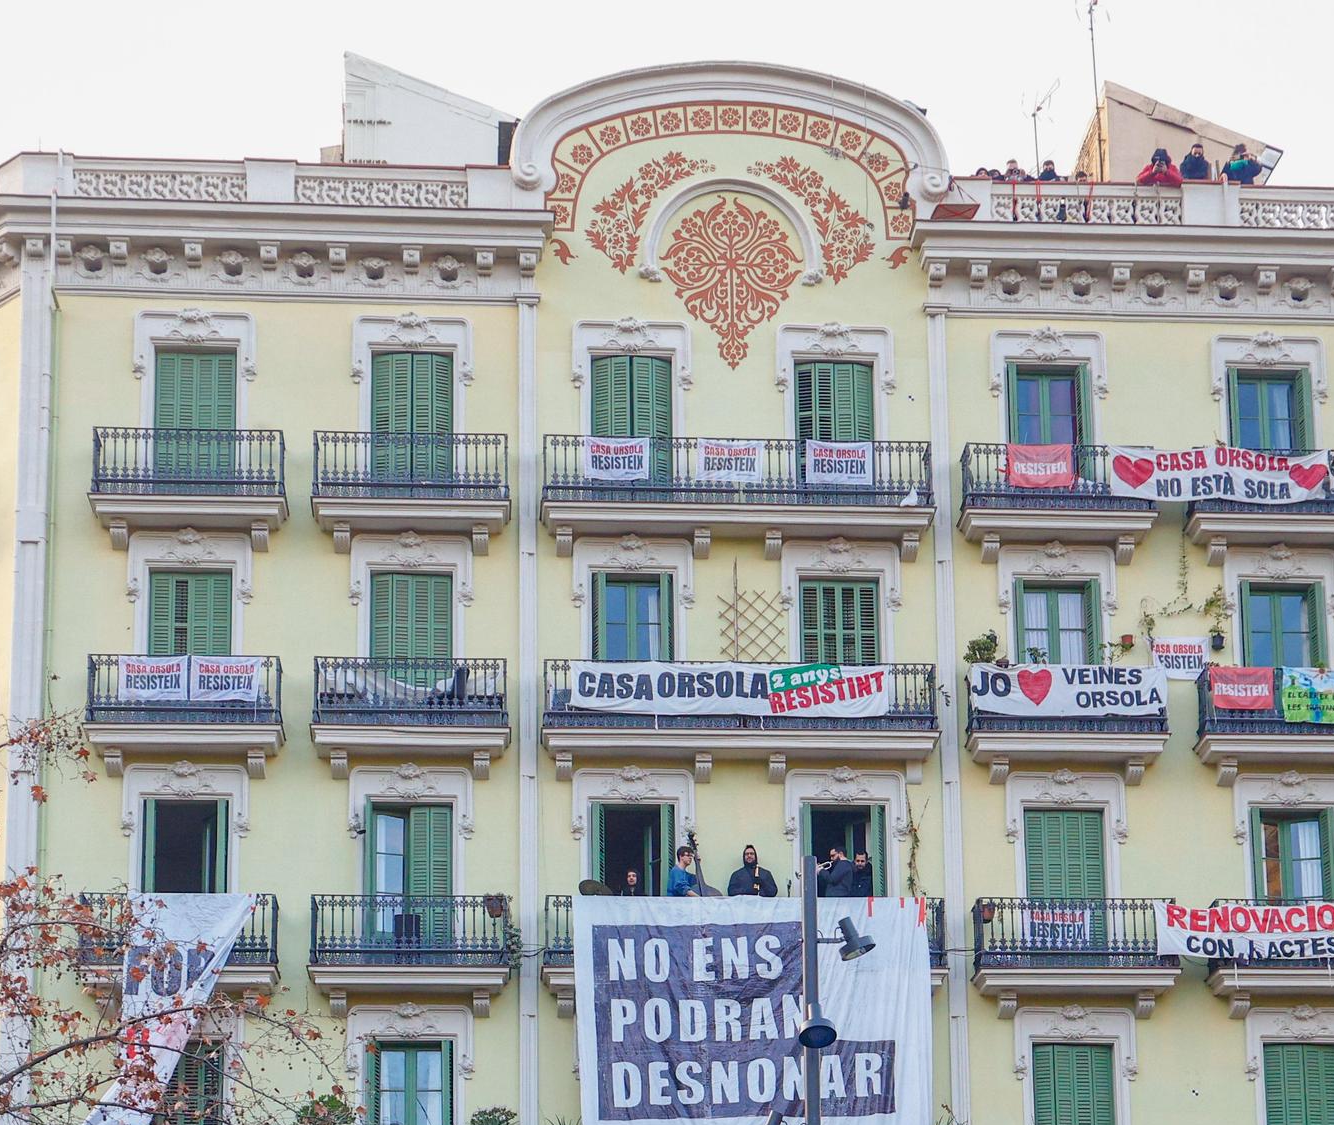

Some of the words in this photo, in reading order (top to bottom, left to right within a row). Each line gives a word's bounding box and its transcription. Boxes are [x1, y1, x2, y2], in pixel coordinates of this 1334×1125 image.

[590, 444, 611, 456] CASA
[613, 444, 644, 456] ORSOLA
[704, 445, 725, 457] CASA
[727, 446, 757, 457] ORSOLA
[813, 447, 834, 459] CASA
[836, 448, 866, 459] ORSOLA
[591, 455, 644, 471] RESISTEIX
[704, 456, 757, 472] RESISTEIX
[813, 458, 866, 474] RESISTEIX
[1156, 450, 1207, 472] CASA
[1216, 446, 1291, 472] ORSOLA
[1156, 477, 1182, 498] NO
[1191, 471, 1235, 496] ESTÀ
[1244, 478, 1291, 500] SOLA
[1173, 644, 1203, 654] ORSOLA
[125, 663, 147, 674] CASA
[150, 663, 181, 674] ORSOLA
[199, 663, 220, 674] CASA
[223, 664, 254, 675] ORSOLA
[1158, 655, 1203, 669] ESISTEIX
[125, 674, 181, 690] RESISTEIX
[198, 675, 254, 691] RESISTEIX
[770, 673, 786, 689] 2
[790, 665, 841, 687] anys
[971, 670, 1012, 698] JO
[578, 671, 654, 700] CASA
[657, 671, 767, 699] ORSOLA
[768, 671, 886, 713] RESISTINT
[1213, 682, 1270, 698] RESISTEIX
[1076, 687, 1163, 709] ORSOLA
[607, 936, 671, 983] NO
[692, 934, 783, 982] ENS
[611, 994, 806, 1043] PODRAN
[611, 1052, 882, 1108] DESNONAR
